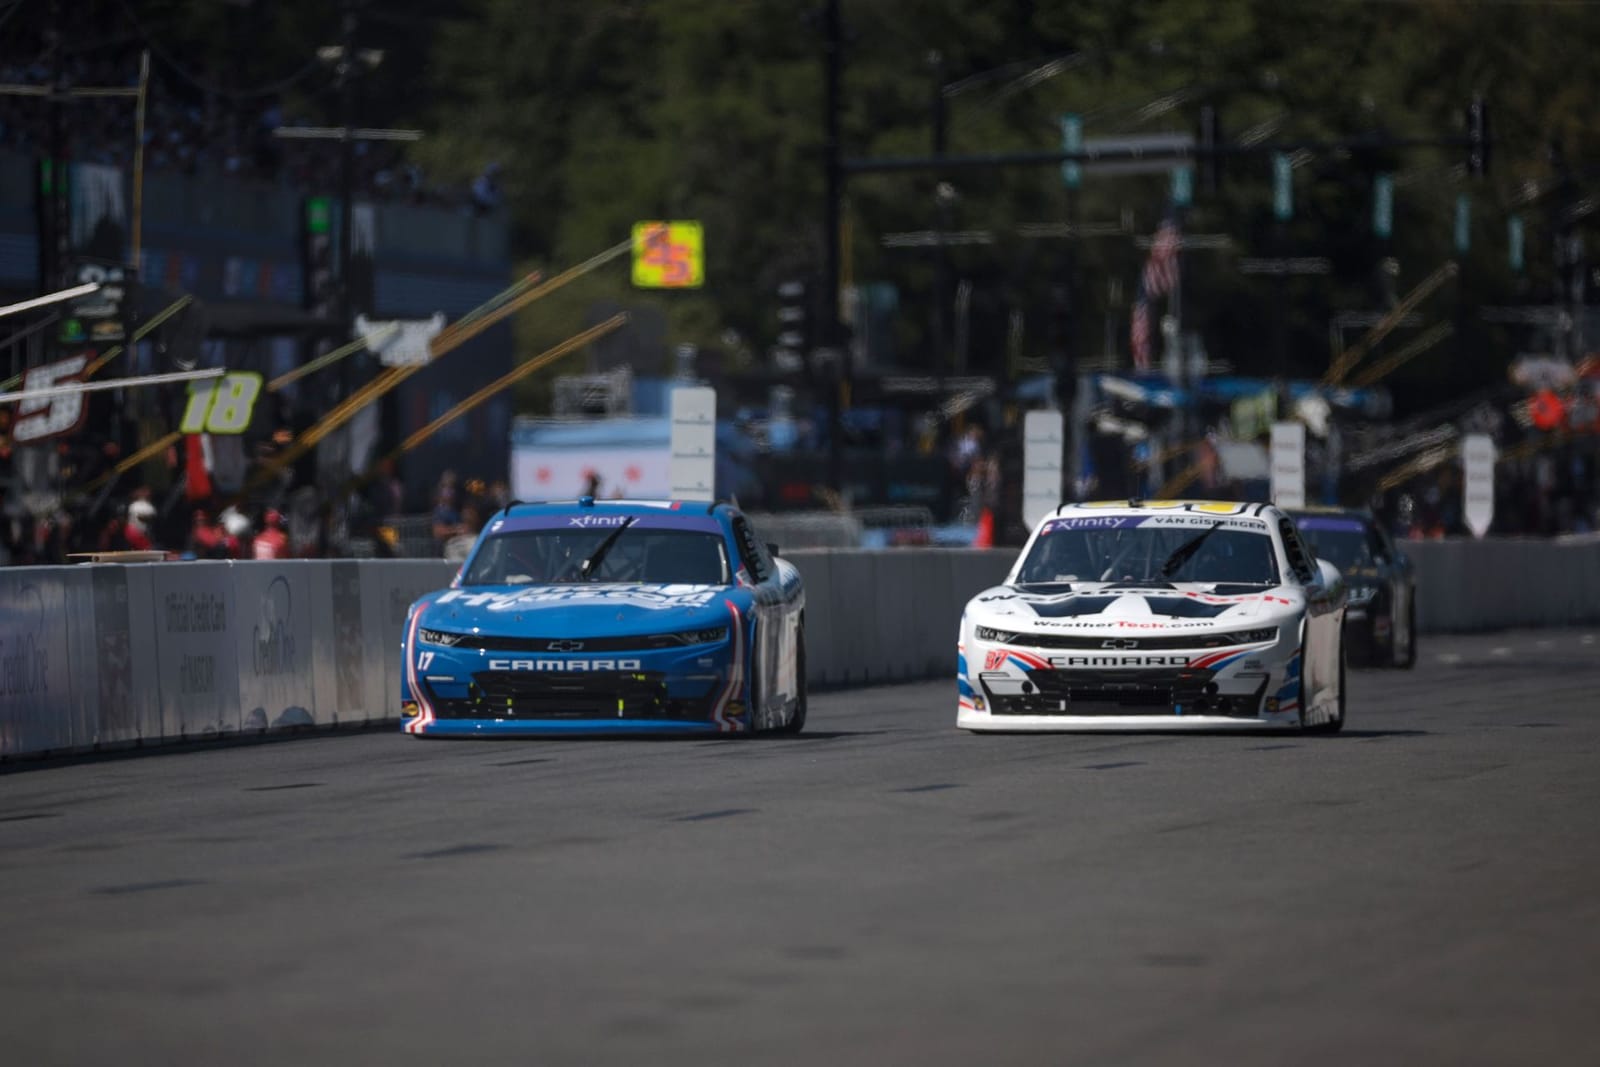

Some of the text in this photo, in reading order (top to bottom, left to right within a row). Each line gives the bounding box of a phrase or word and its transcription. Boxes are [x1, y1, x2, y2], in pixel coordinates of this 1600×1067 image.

[179, 371, 263, 434] 18
[570, 515, 640, 528] xfinity
[1056, 516, 1127, 530] xfinity
[1034, 620, 1215, 630] WeatherTech.com
[417, 652, 435, 671] 17
[489, 659, 641, 671] CAMARO
[1048, 656, 1191, 667] CAMARO
